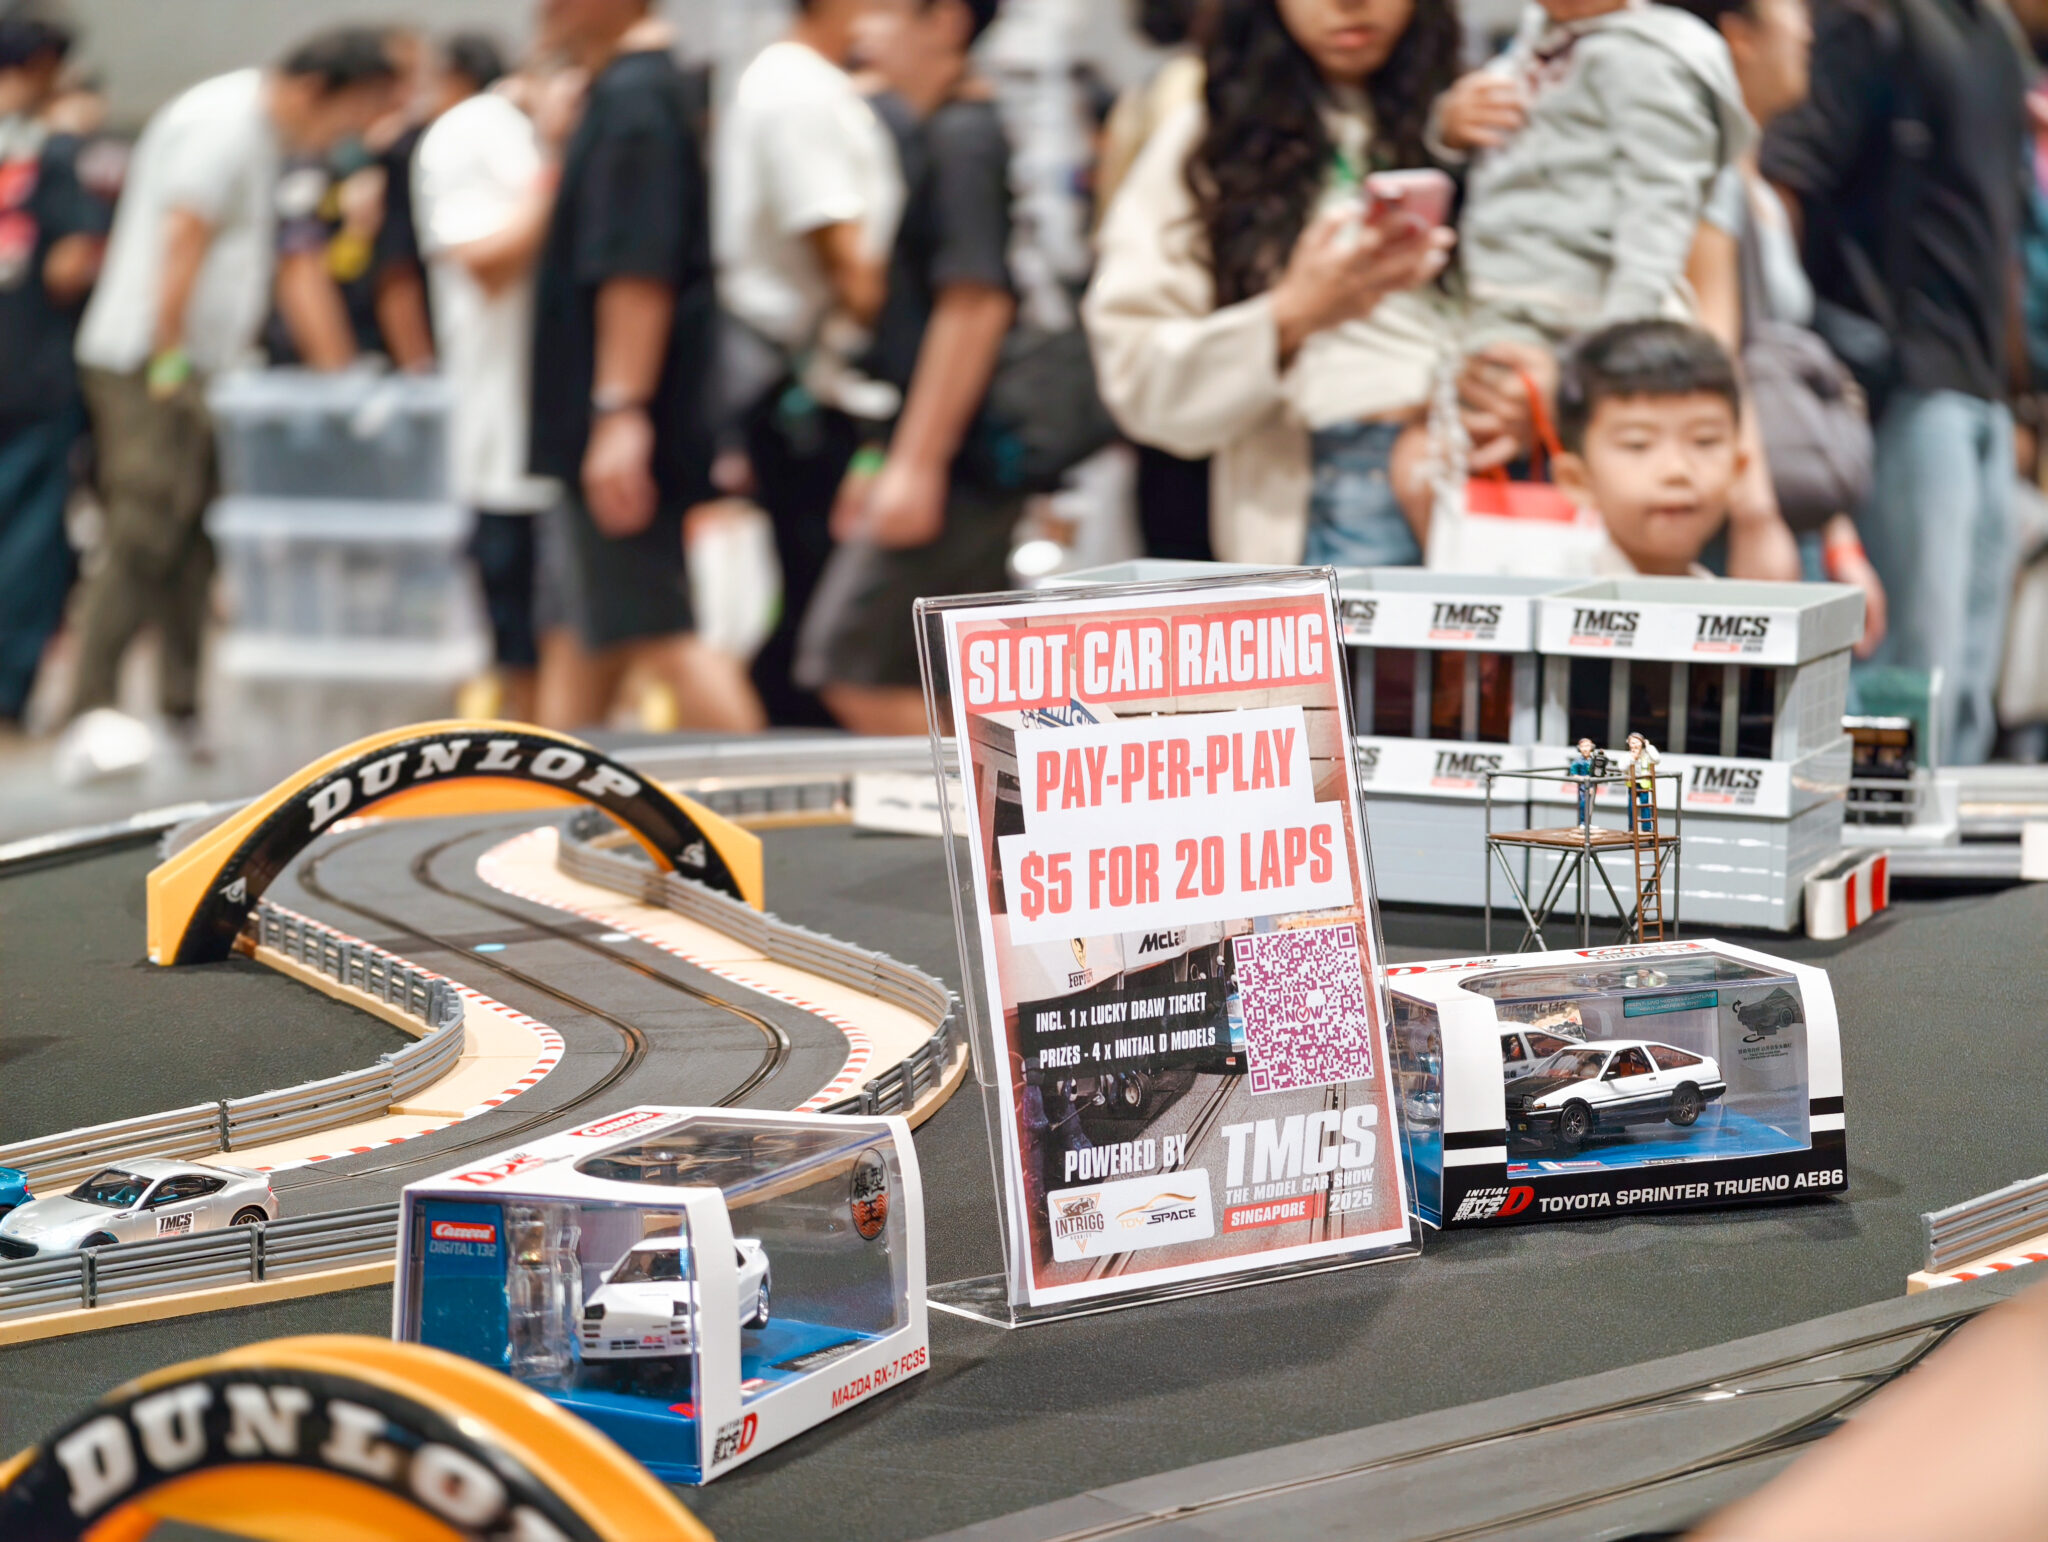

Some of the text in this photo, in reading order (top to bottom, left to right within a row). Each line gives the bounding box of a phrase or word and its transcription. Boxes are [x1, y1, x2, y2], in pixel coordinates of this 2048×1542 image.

[1431, 602, 1502, 625] TMCS
[1573, 608, 1640, 632] TMCS
[1697, 614, 1770, 638] TMCS
[968, 613, 1324, 705] SLOT CAR RACING
[1036, 727, 1296, 812] PAY-PER-PLAY
[1434, 750, 1503, 774] TMCS
[307, 738, 642, 832] DUNLOP
[1692, 765, 1763, 789] TMCS
[1020, 823, 1333, 922] $5 FOR 20 LAPS
[1036, 1012, 1067, 1033] INCL.
[1069, 1008, 1076, 1028] 1
[1090, 1001, 1128, 1026] LUCKY
[1130, 998, 1166, 1021] DRAW
[1168, 992, 1206, 1016] TICKET
[1283, 992, 1308, 1008] PAY
[1039, 1045, 1081, 1069] PRIZES
[1091, 1042, 1100, 1062] 4
[1115, 1035, 1156, 1059] INITIAL
[1159, 1033, 1167, 1052] D
[1171, 1027, 1216, 1049] MODELS
[1064, 1133, 1188, 1183] POWERED BY
[1221, 1104, 1378, 1188] TMCS
[1225, 1168, 1374, 1206] THE MODEL CAR SHOW
[1329, 1188, 1374, 1212] 2025
[1465, 1186, 1510, 1198] INITIAL
[1496, 1185, 1535, 1217] D
[1539, 1168, 1844, 1213] TOYOTA SPRINTER TRUENO AE86
[160, 1212, 192, 1230] TMCS
[1055, 1213, 1105, 1238] INTRIGG
[1119, 1208, 1197, 1230] TOY SPACE
[1231, 1200, 1306, 1227] SINGAPORE
[429, 1239, 497, 1257] DIGITAL 132
[830, 1346, 927, 1410] MAZDA RX-7 FC3S
[736, 1411, 758, 1456] D
